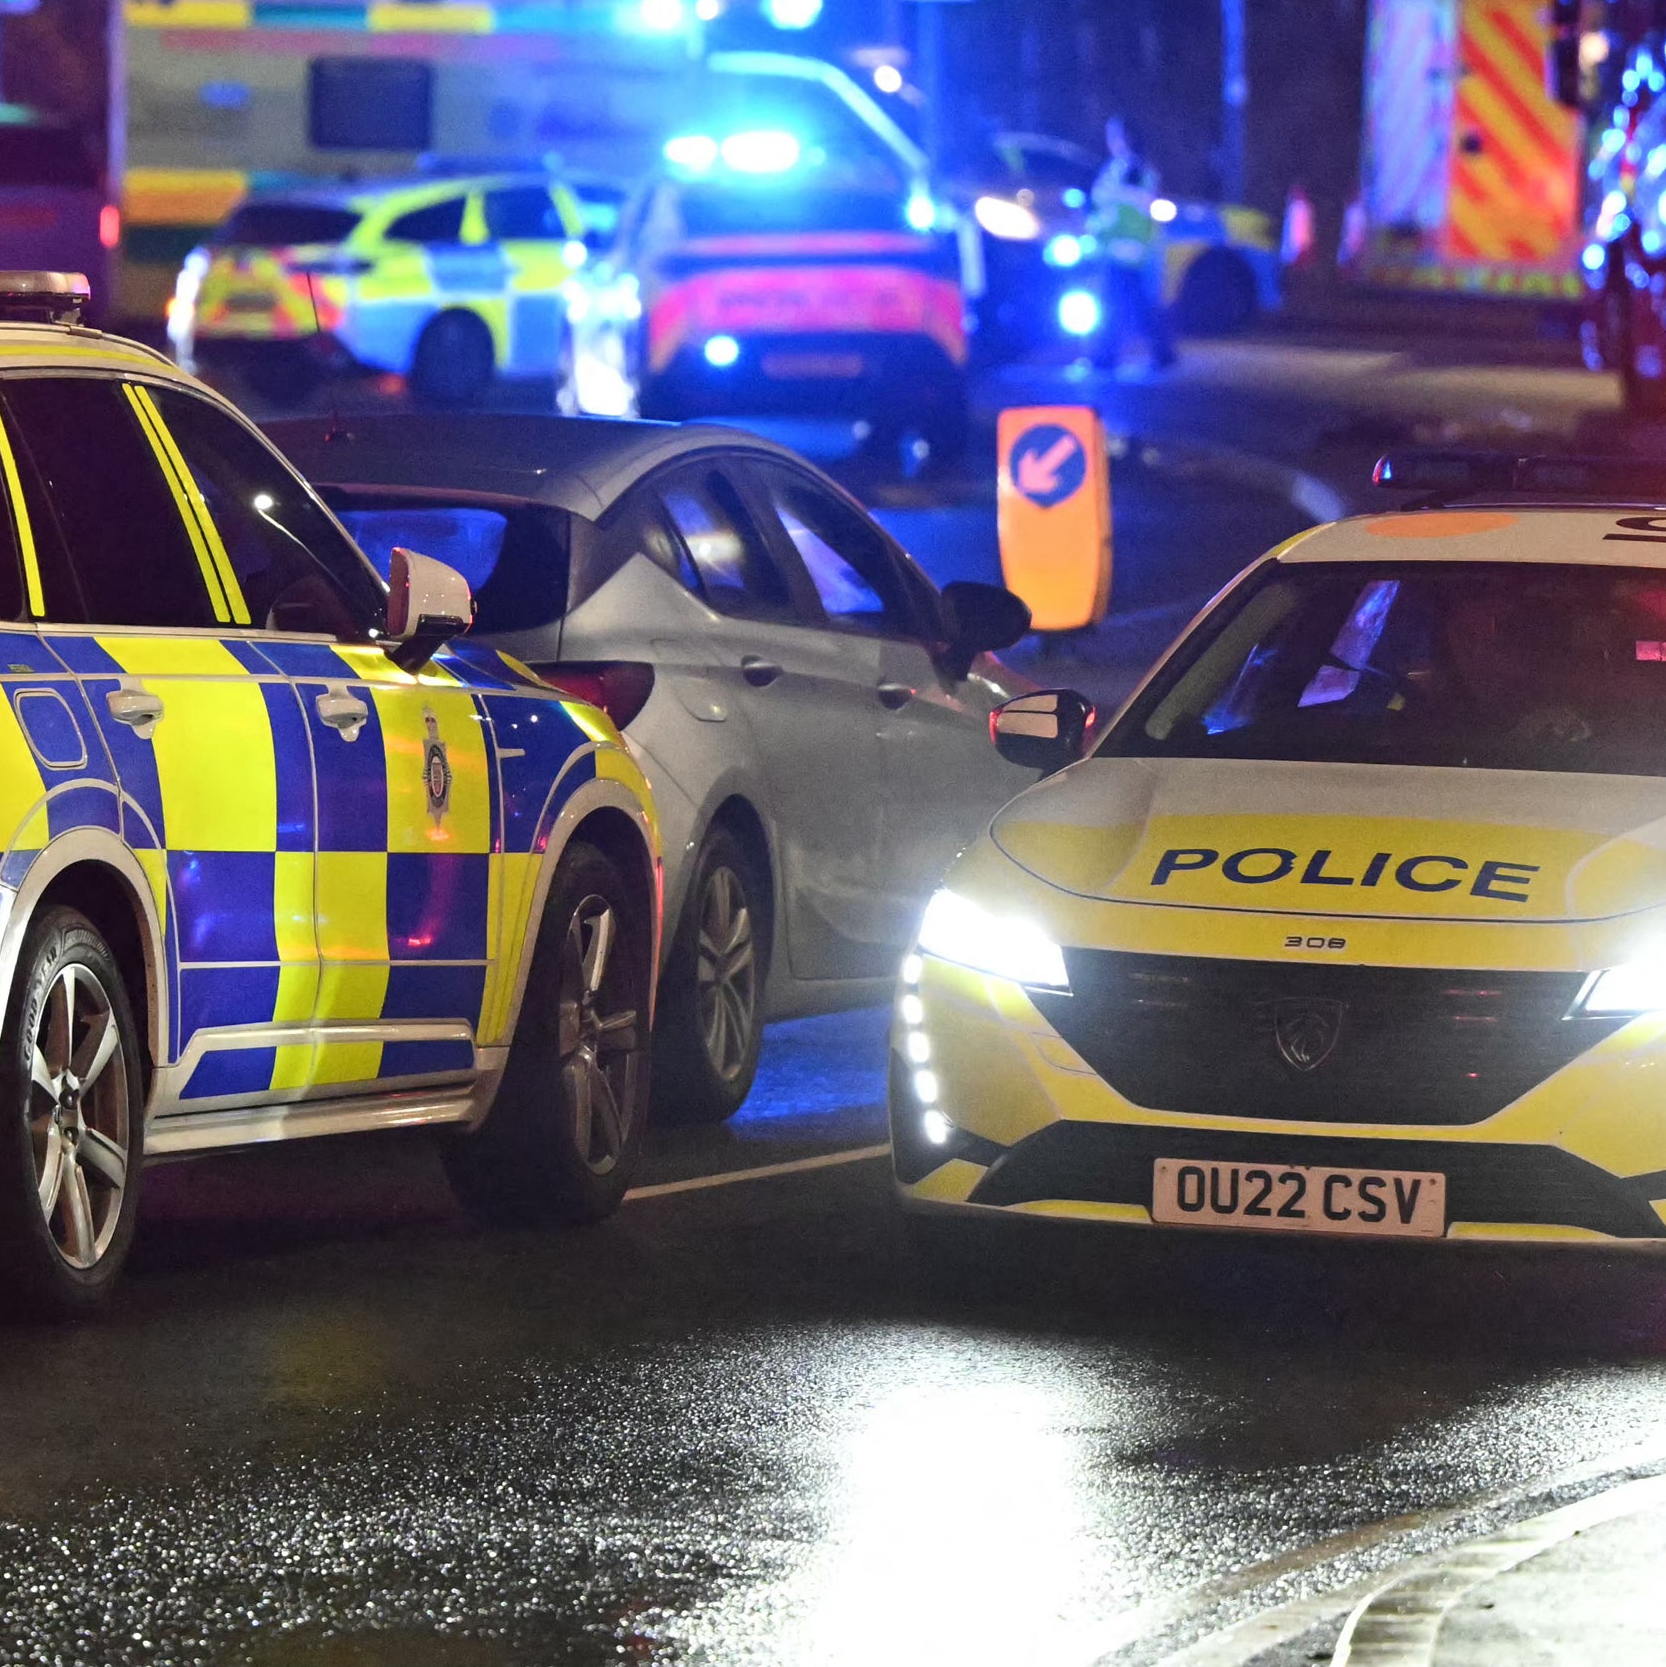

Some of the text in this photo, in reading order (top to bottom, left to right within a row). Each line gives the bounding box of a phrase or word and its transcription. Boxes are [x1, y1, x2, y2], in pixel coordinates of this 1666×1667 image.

[1150, 847, 1541, 903] POLICE
[1284, 936, 1346, 949] 308
[1177, 1165, 1422, 1225] OU22 CSV
